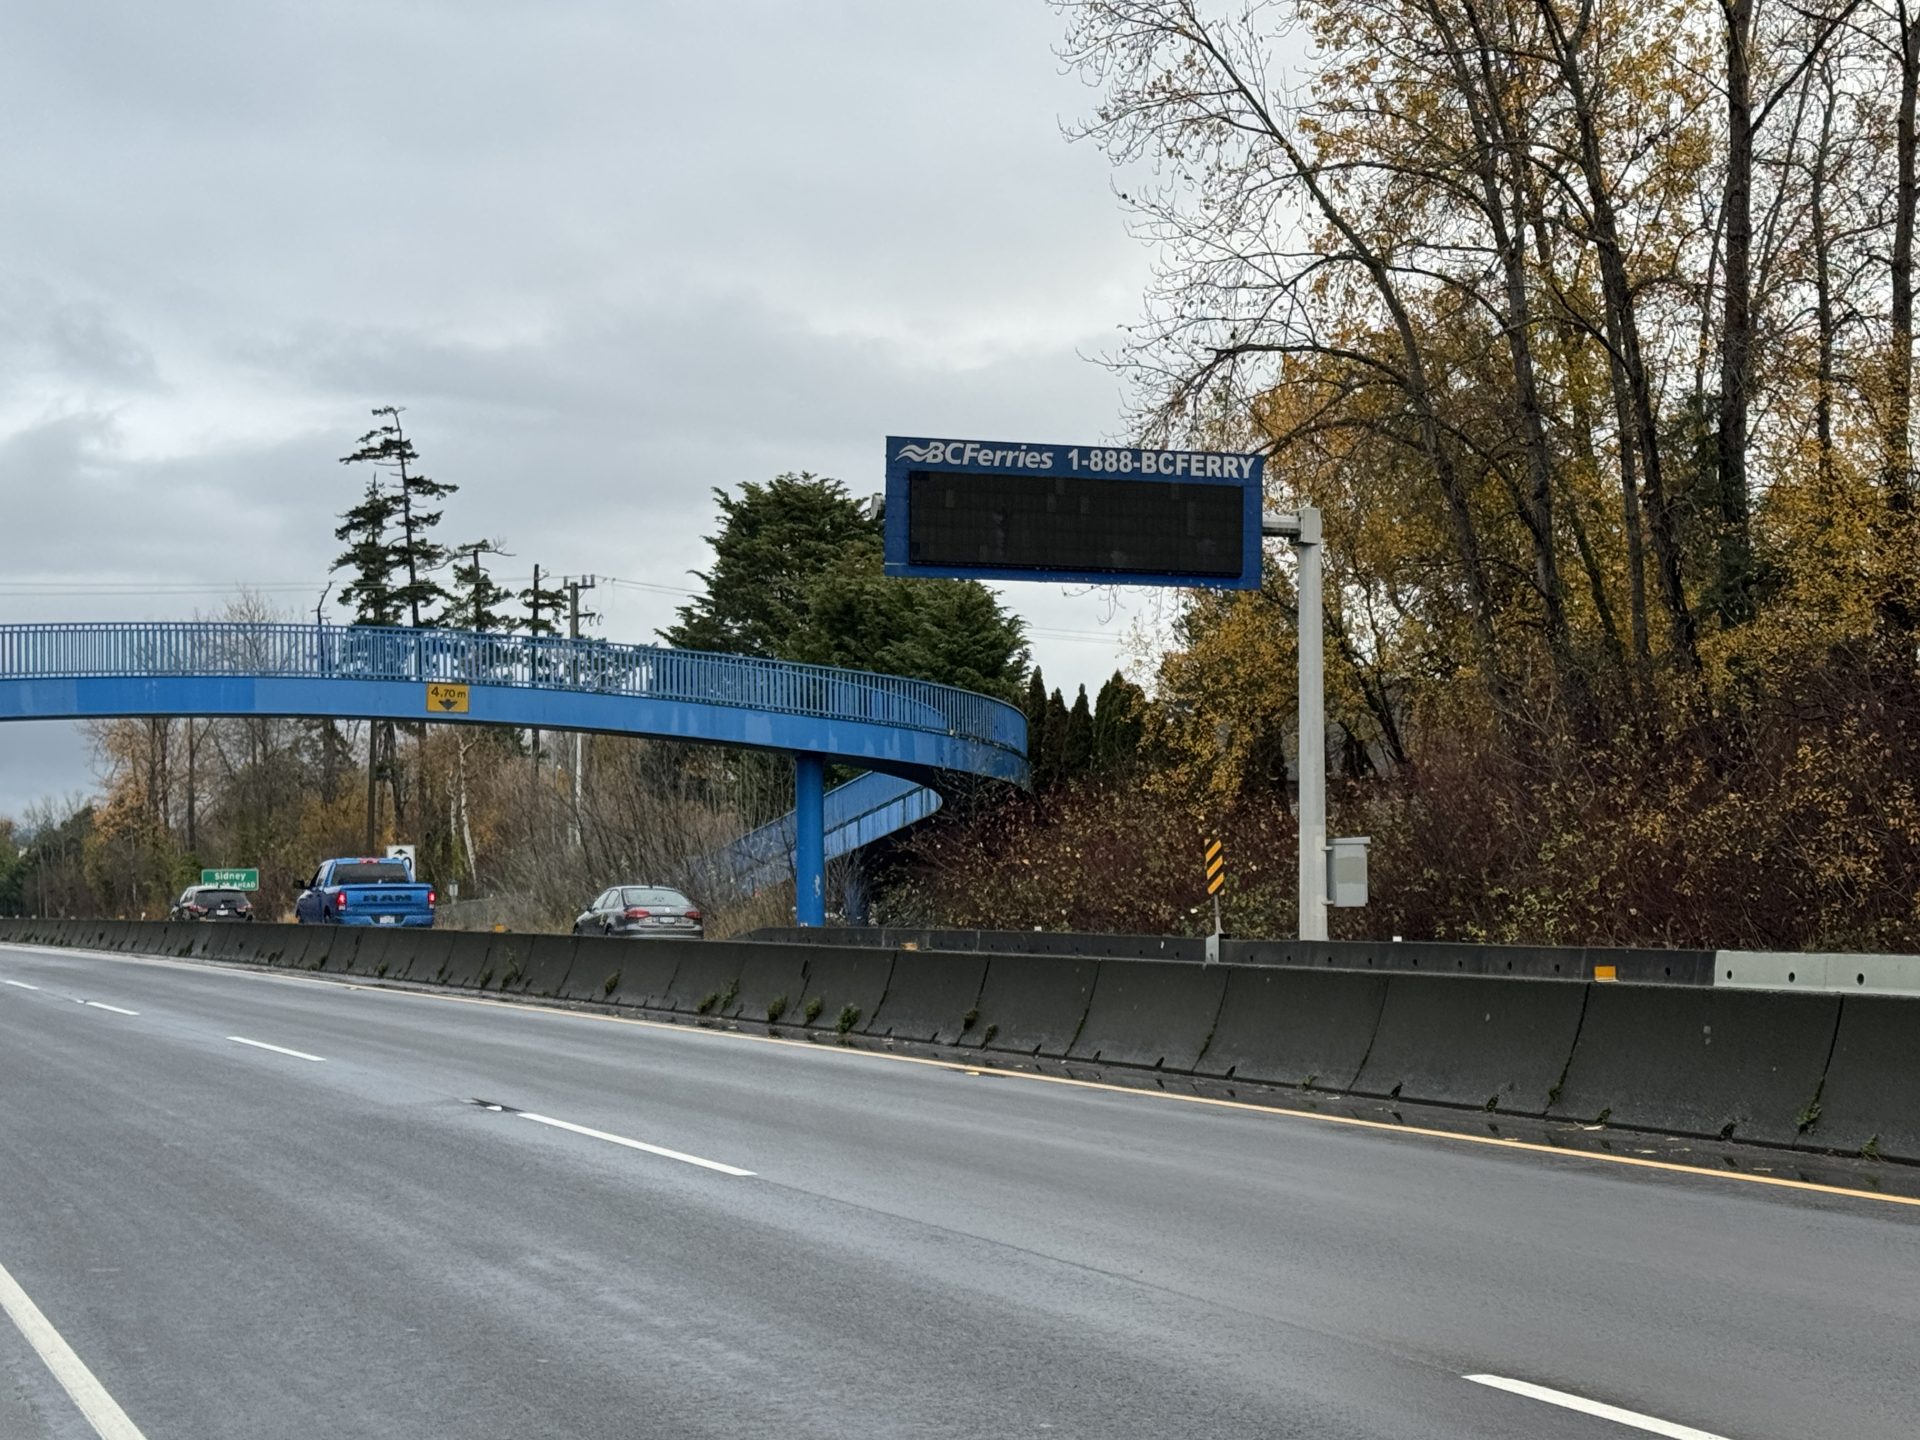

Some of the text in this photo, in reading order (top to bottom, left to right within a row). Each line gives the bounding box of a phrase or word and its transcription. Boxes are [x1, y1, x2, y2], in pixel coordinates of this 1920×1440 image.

[925, 441, 1255, 479] BCFerries 1-888-BCFERRY
[214, 872, 247, 881] Sidney
[363, 894, 412, 902] RAM
